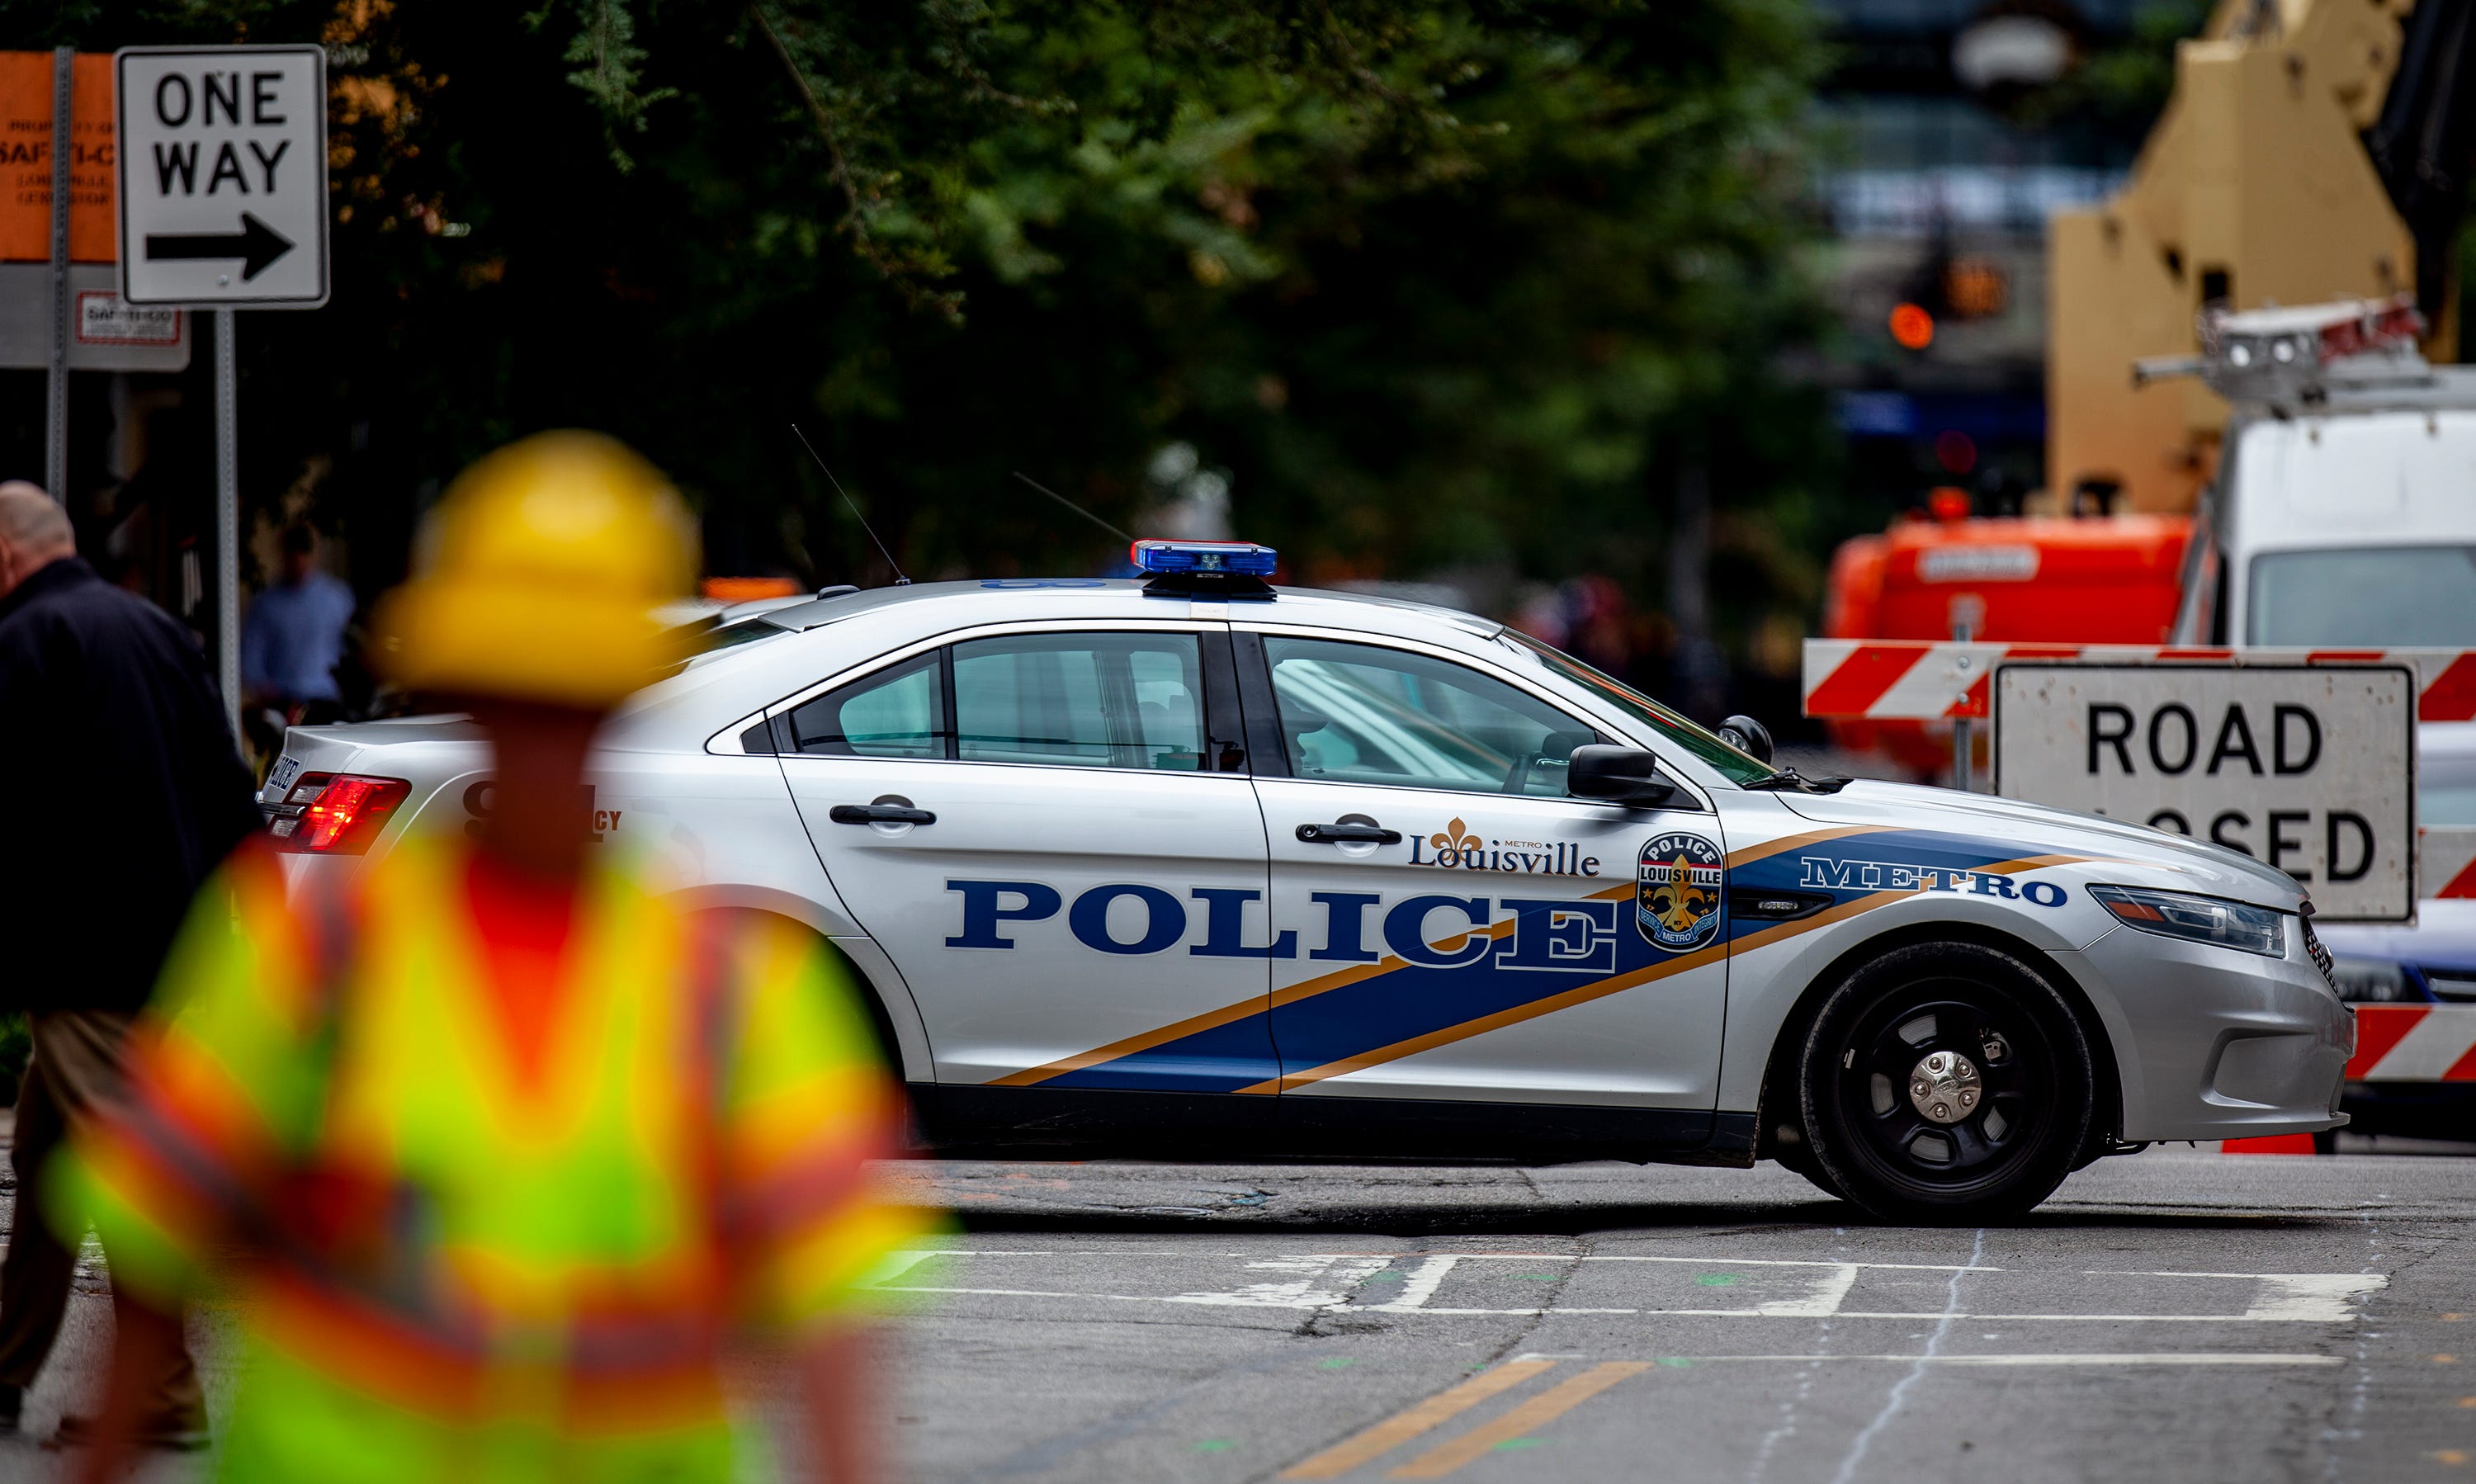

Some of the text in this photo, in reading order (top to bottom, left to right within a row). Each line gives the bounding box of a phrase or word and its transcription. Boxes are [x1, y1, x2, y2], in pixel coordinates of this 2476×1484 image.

[154, 72, 288, 128] ONE
[154, 139, 291, 196] WAY
[2086, 703, 2323, 776] ROAD
[1408, 834, 1600, 877] Louisville
[1505, 840, 1543, 848] METRO
[1647, 837, 1717, 864] POLICE
[2095, 809, 2375, 884] SED
[1639, 867, 1721, 885] LOUISVILLE
[1800, 856, 2068, 908] METRO
[943, 877, 1618, 974] POLICE
[1640, 910, 1661, 933] SERVICE
[1662, 932, 1691, 943] METRO
